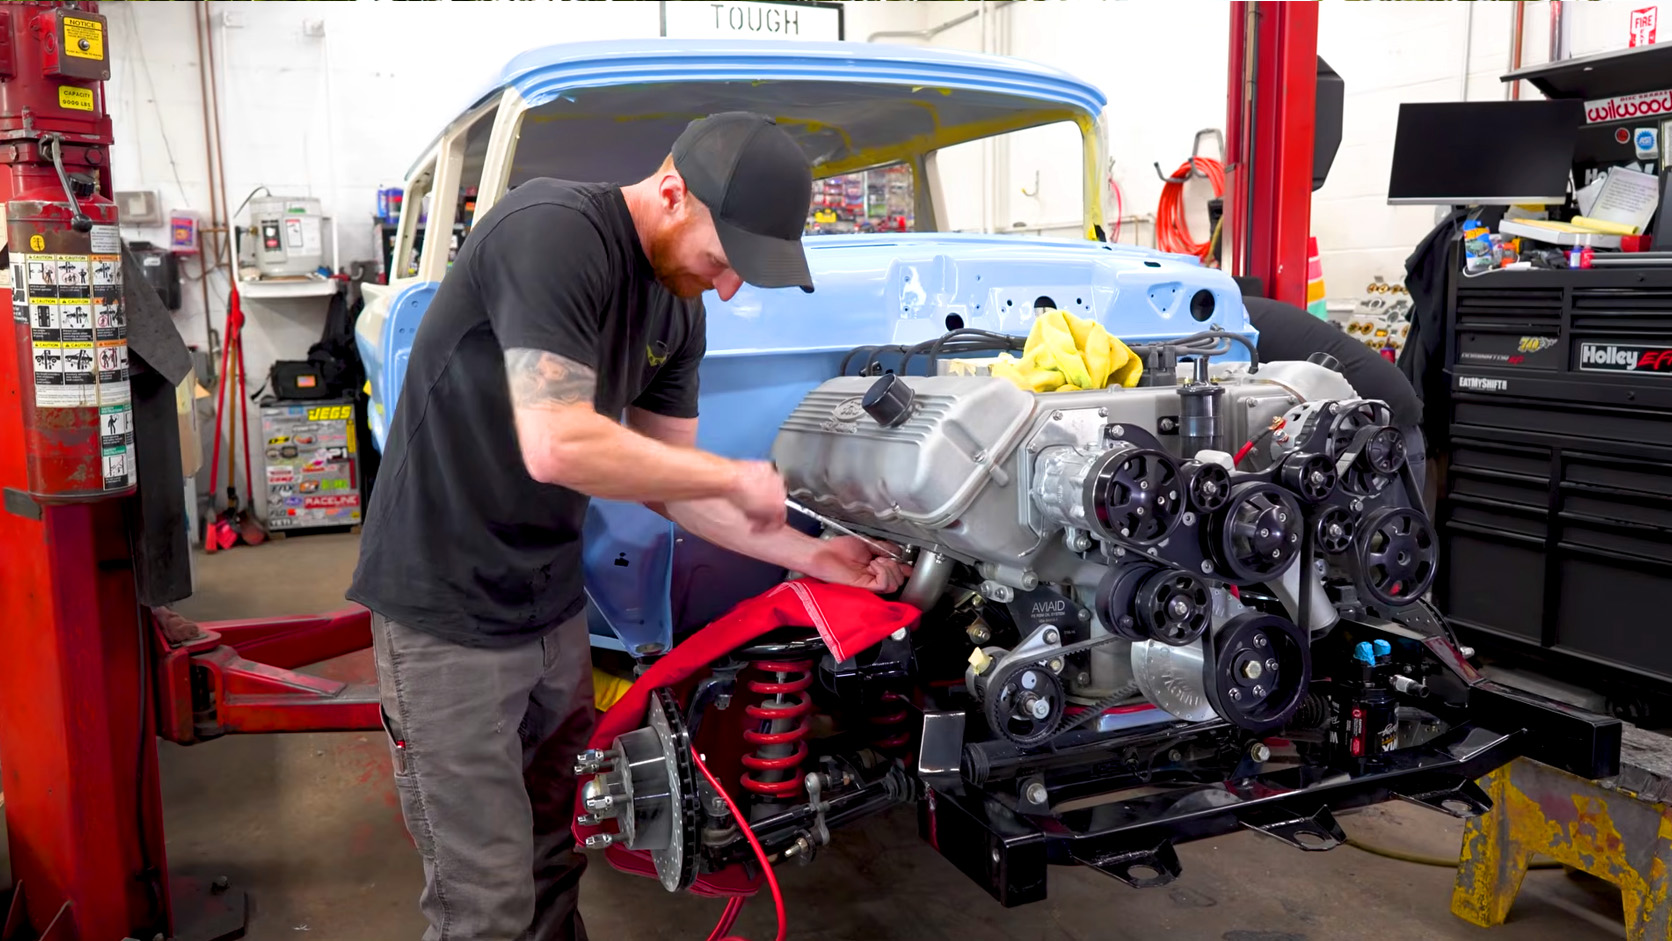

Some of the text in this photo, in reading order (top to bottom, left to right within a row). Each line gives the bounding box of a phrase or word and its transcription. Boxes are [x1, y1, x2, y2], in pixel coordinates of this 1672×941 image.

[69, 19, 95, 27] NOTICE
[711, 4, 799, 35] TOUGH
[1634, 15, 1653, 29] FIRE
[1582, 345, 1638, 370] Holley
[308, 406, 352, 421] JEGS
[305, 495, 357, 506] RACELINE
[1032, 600, 1065, 613] AVIAID
